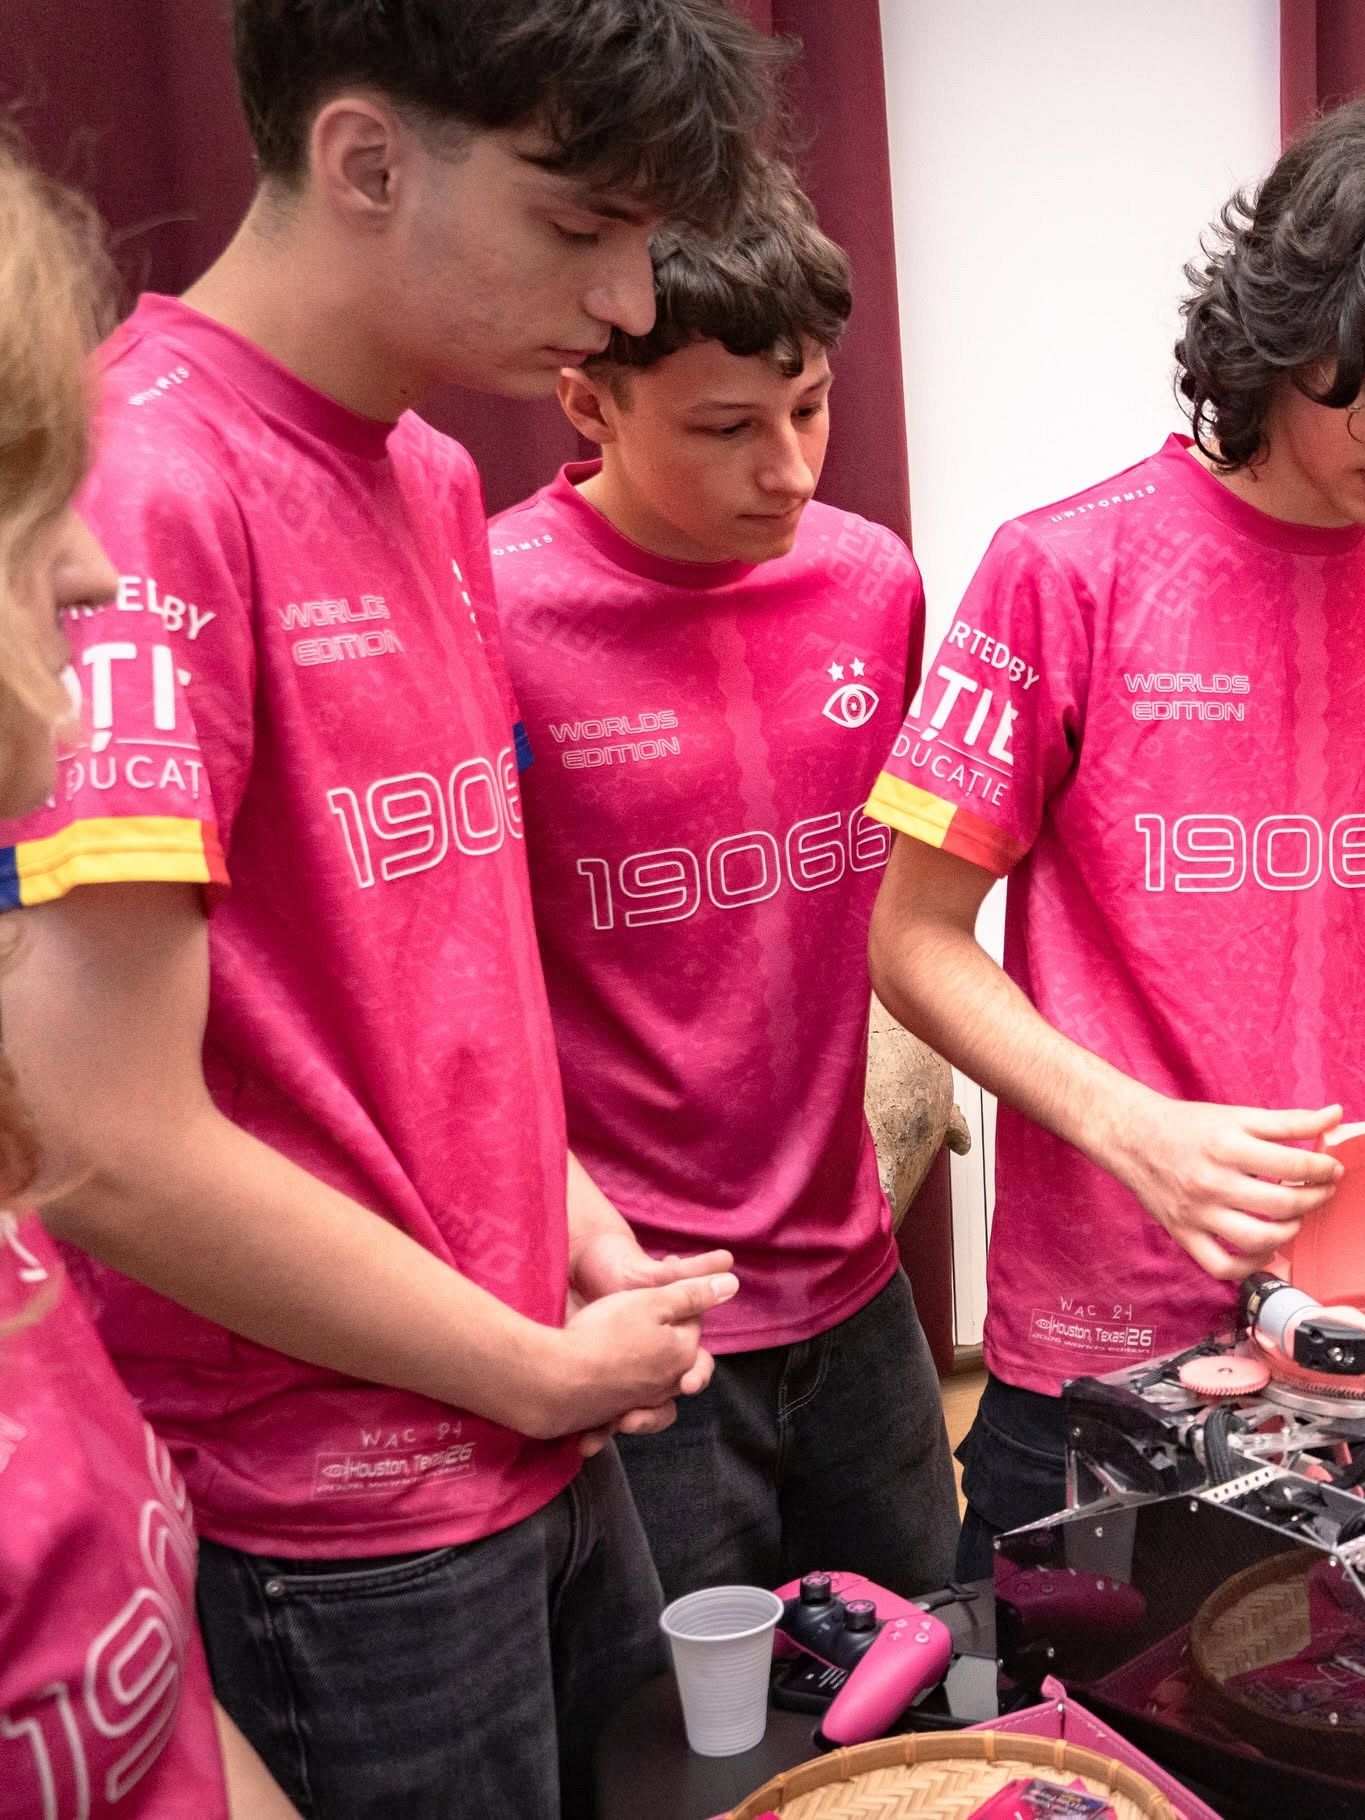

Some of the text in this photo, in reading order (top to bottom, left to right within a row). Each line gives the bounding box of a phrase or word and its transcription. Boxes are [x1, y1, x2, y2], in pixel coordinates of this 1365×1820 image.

[1124, 673, 1250, 695] WORLDS
[1132, 700, 1246, 722] EDITION
[549, 710, 679, 743] WORLDS
[562, 737, 681, 770] EDITION
[577, 803, 892, 930] 19066
[1095, 1328, 1125, 1343] Texas
[1127, 1328, 1153, 1347] 26
